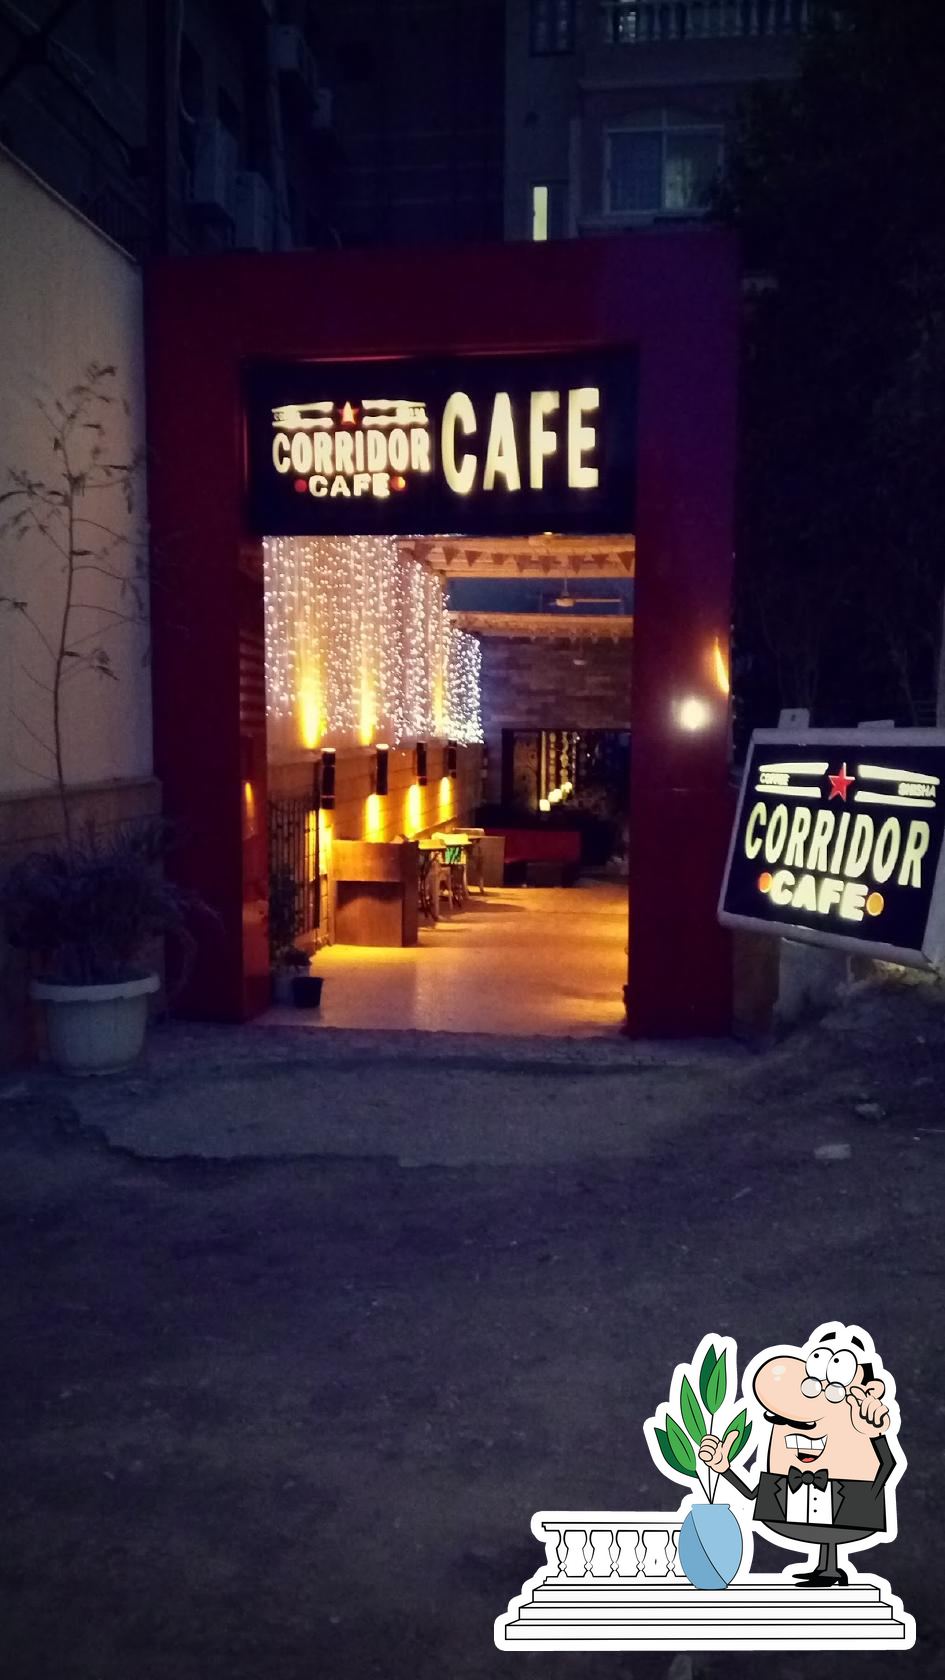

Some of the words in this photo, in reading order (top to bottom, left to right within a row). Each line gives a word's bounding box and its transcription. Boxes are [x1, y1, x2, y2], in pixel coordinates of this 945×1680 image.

[272, 427, 431, 474] CORRIDOR
[441, 387, 600, 495] CAFE
[308, 472, 390, 498] CAFE
[745, 801, 930, 889] CORRIDOR
[769, 869, 869, 922] CAFE
